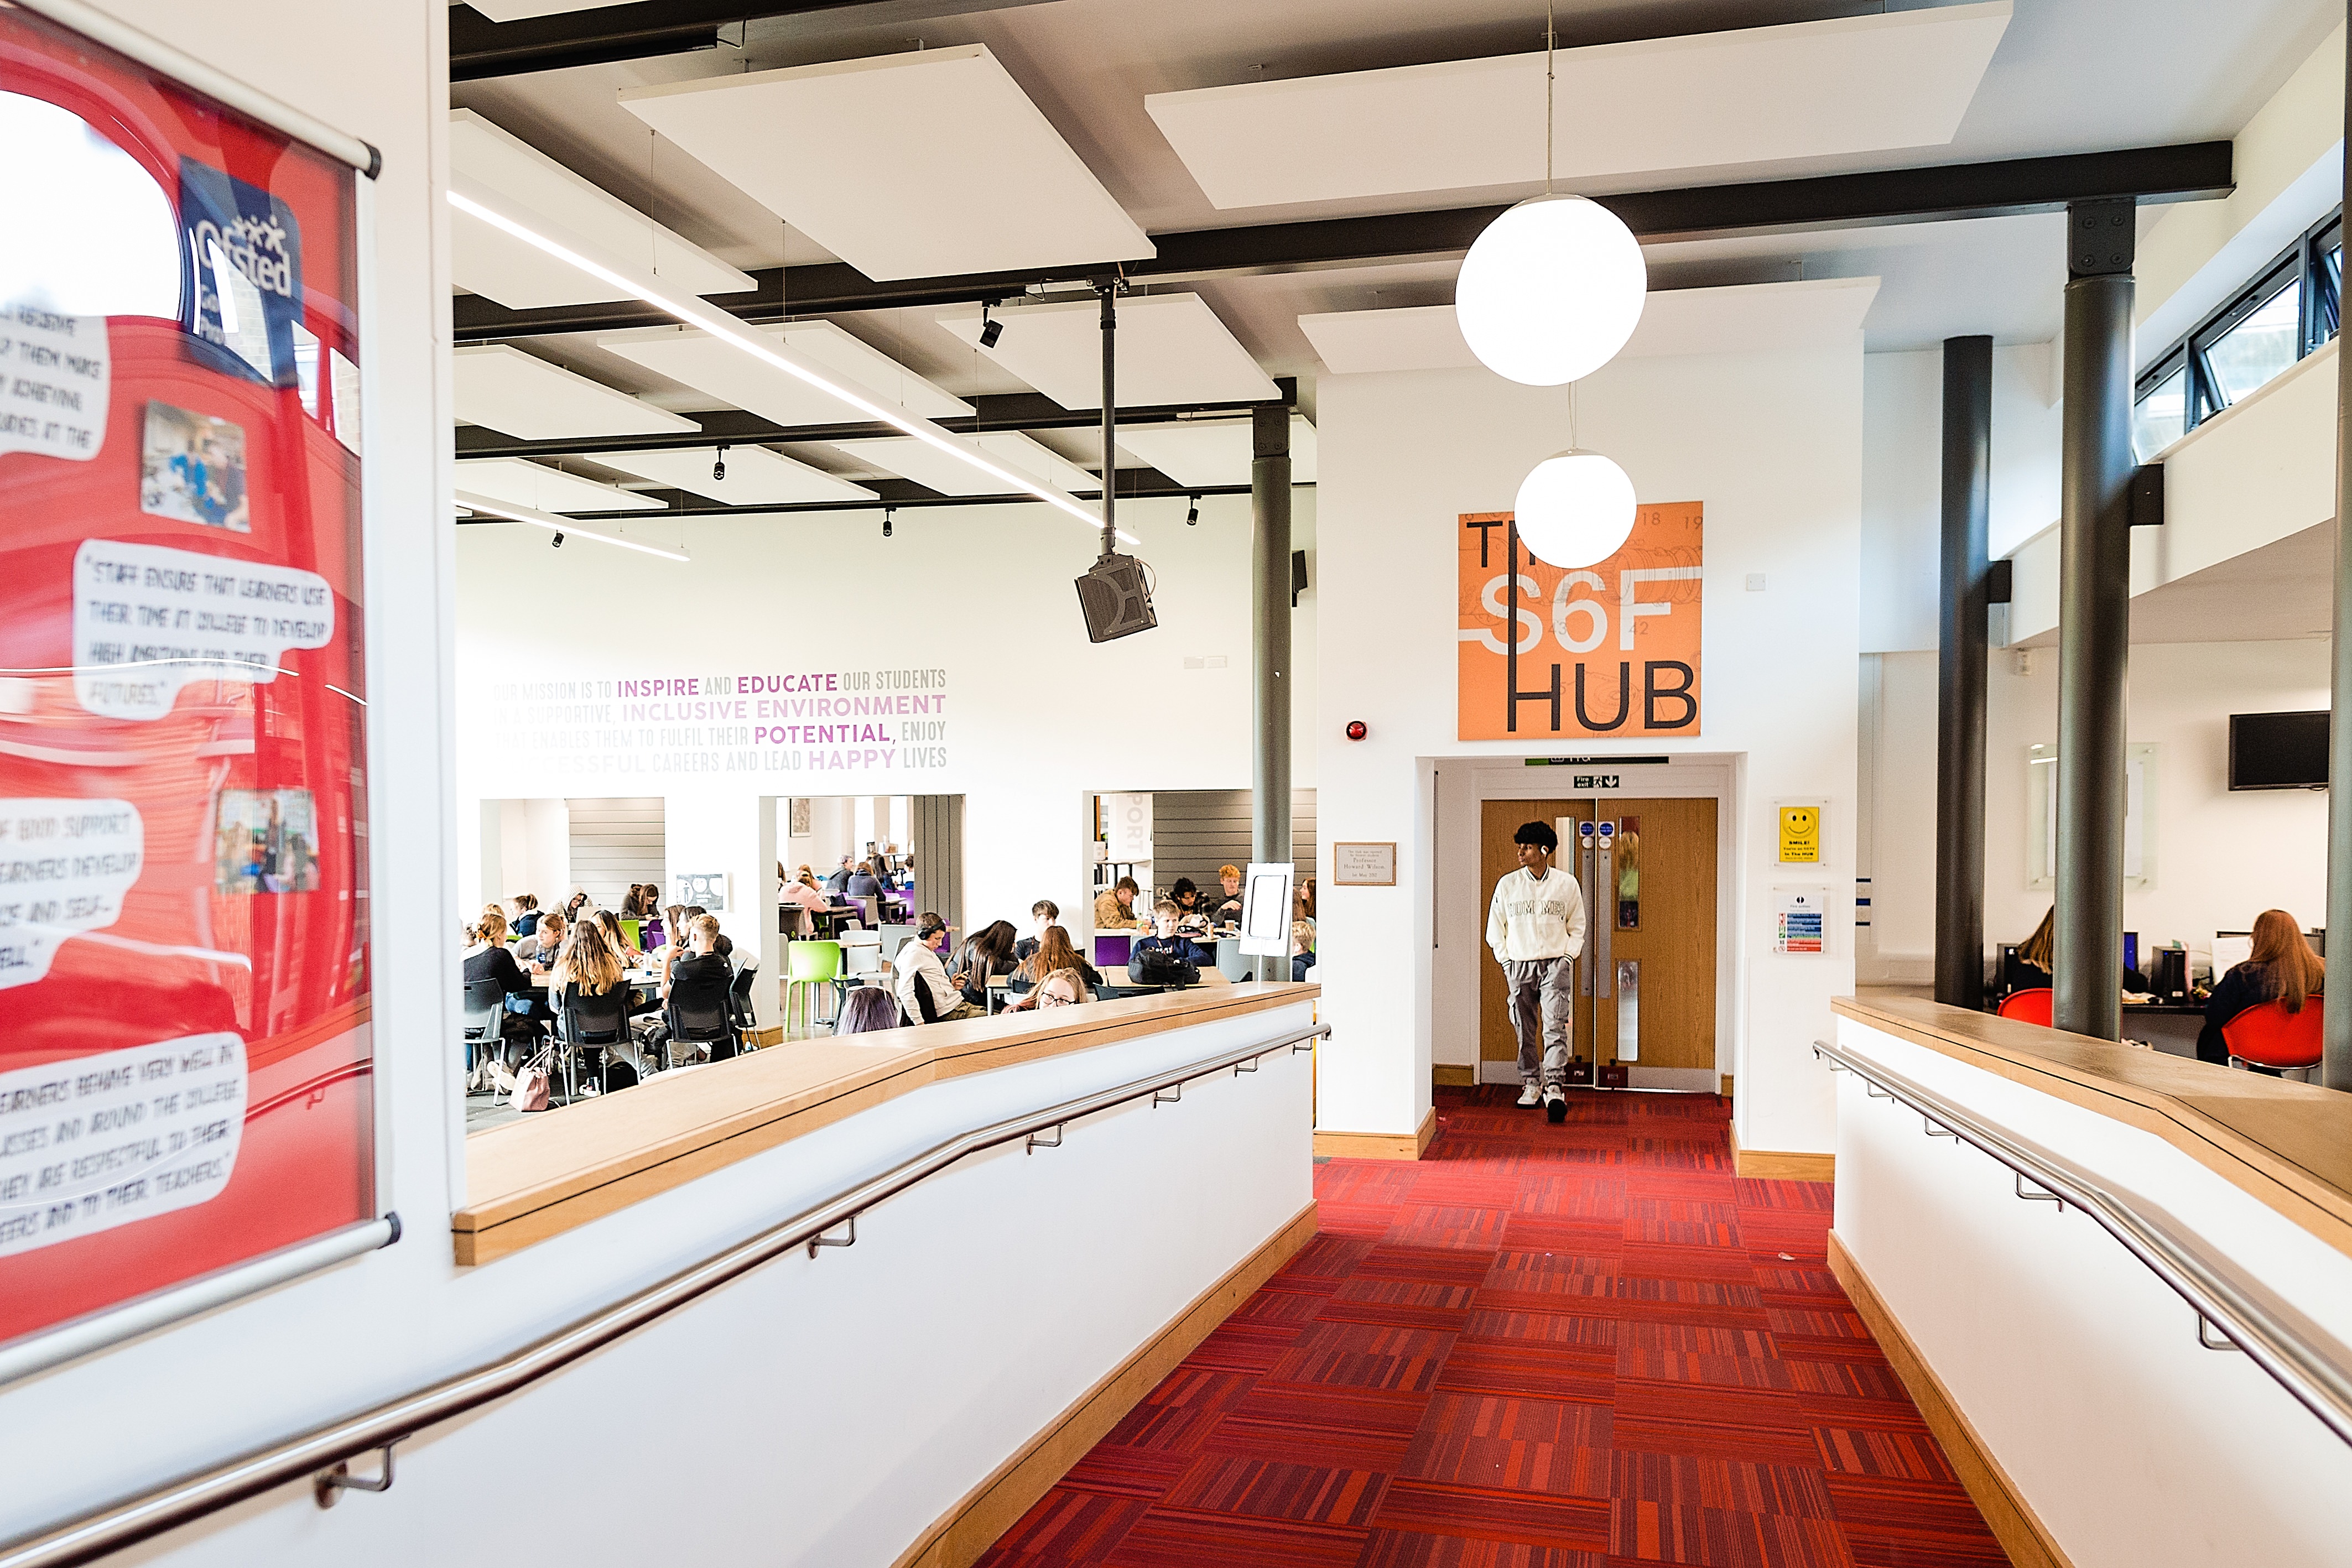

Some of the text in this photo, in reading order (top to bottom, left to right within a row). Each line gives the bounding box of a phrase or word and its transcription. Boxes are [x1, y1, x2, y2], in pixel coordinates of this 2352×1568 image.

[1458, 565, 1702, 655] S6F
[493, 669, 946, 701] OUR MISSION IS TO INSPIRE AND EDUCATE OUR STUDENTS
[1507, 661, 1697, 732] HUB
[623, 701, 747, 722] INCLUSIVE
[757, 695, 946, 718] ENVIRONMENT
[595, 730, 632, 748] THEM
[638, 729, 653, 747] TO
[660, 727, 703, 747] FULFIL
[708, 727, 747, 746] THEIR
[754, 723, 896, 745] POTENTIAL,
[902, 721, 946, 742] ENJOY
[653, 752, 719, 773] CAREERS
[726, 751, 757, 772] AND
[764, 750, 801, 770] LEAD
[809, 749, 896, 770] HAPPY
[903, 747, 946, 769] LIVES
